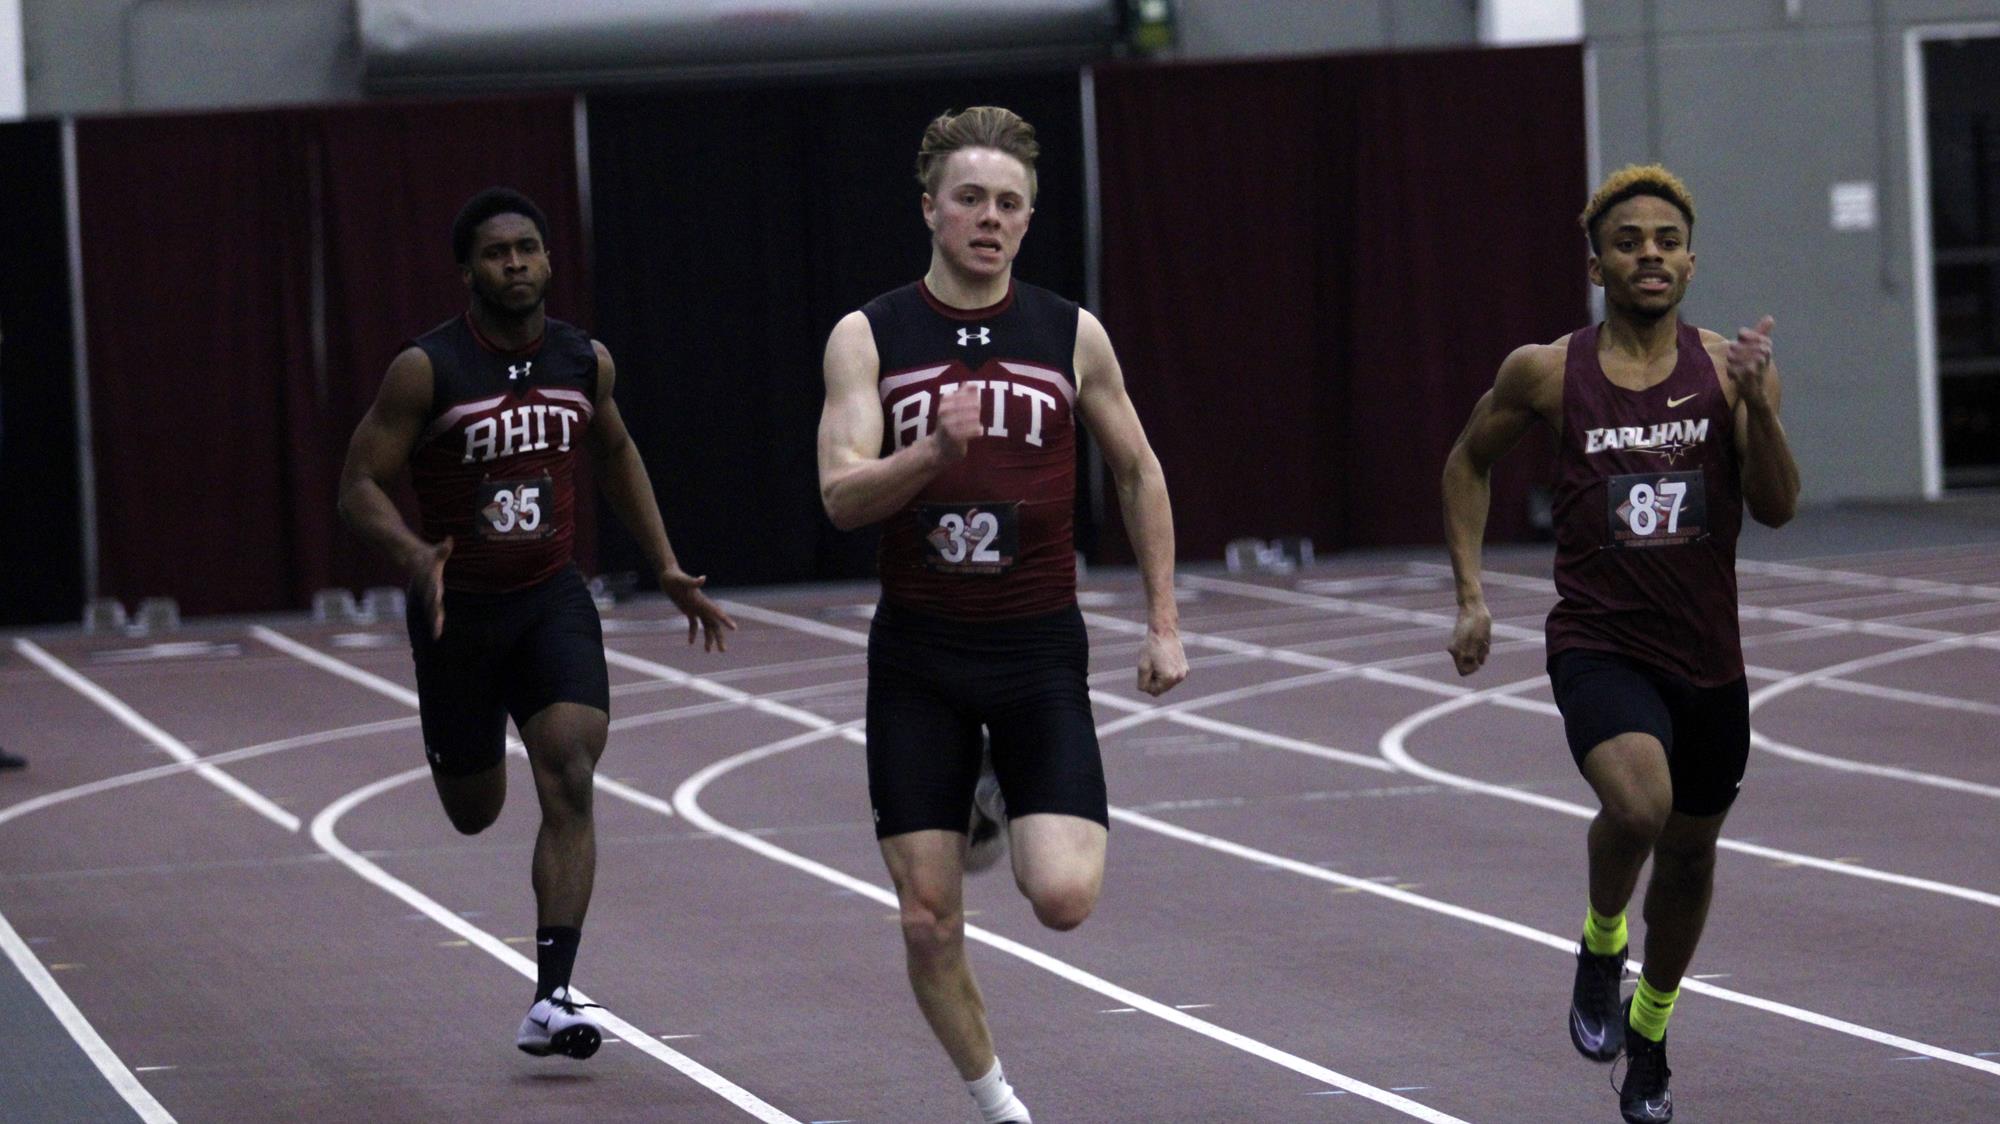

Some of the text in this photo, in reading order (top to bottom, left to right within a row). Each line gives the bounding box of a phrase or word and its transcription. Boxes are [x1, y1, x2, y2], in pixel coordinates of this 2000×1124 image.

[1585, 418, 1709, 454] EARLHAM
[493, 487, 541, 533] 35
[1629, 482, 1687, 535] 87
[938, 512, 1000, 563] 32
